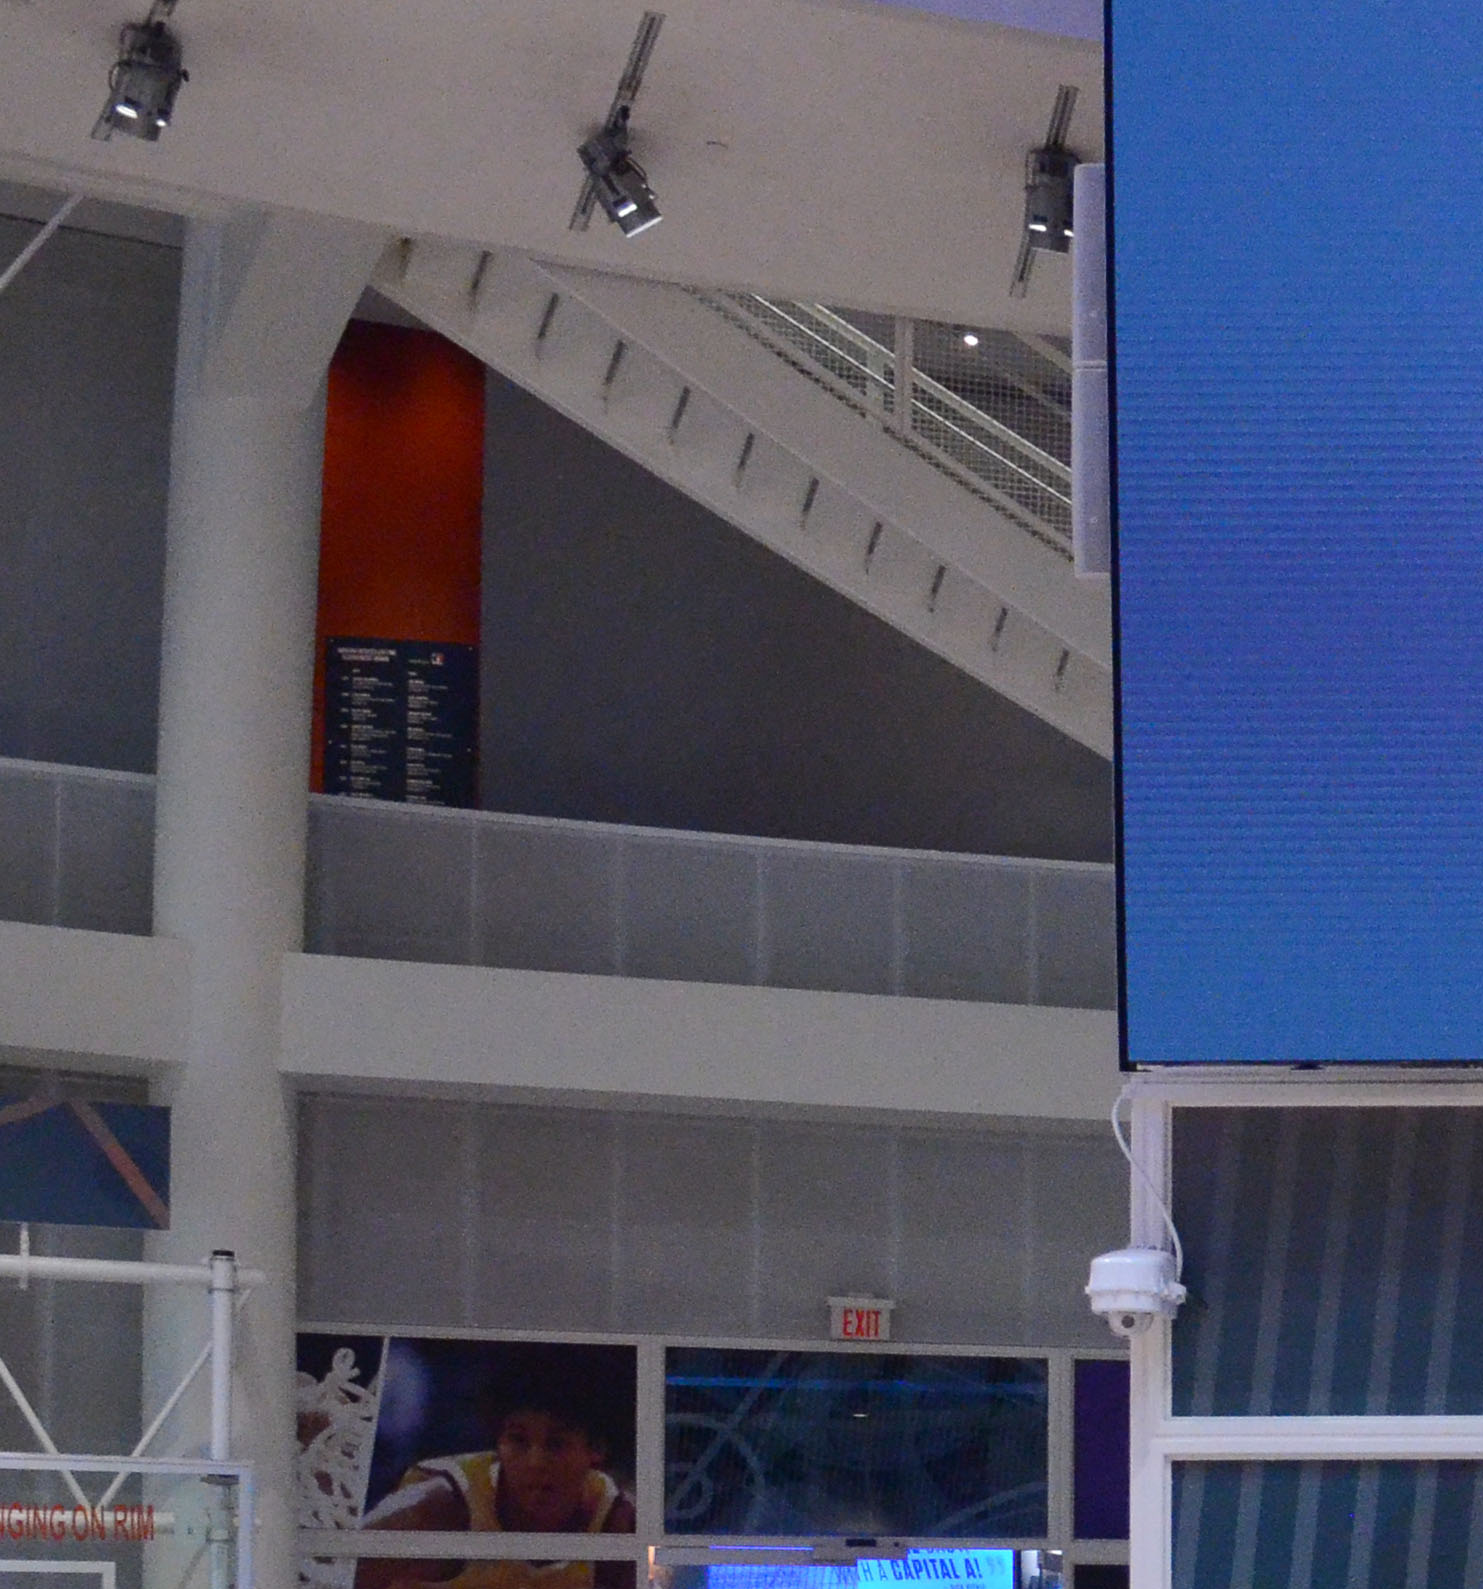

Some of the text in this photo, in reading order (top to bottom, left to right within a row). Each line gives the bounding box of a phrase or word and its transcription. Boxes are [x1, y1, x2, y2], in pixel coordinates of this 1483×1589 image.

[843, 1308, 880, 1337] EXIT
[71, 1505, 105, 1541] ON
[113, 1505, 155, 1541] RIM
[890, 1557, 960, 1581] CAPITAL
[965, 1556, 984, 1580] A!
